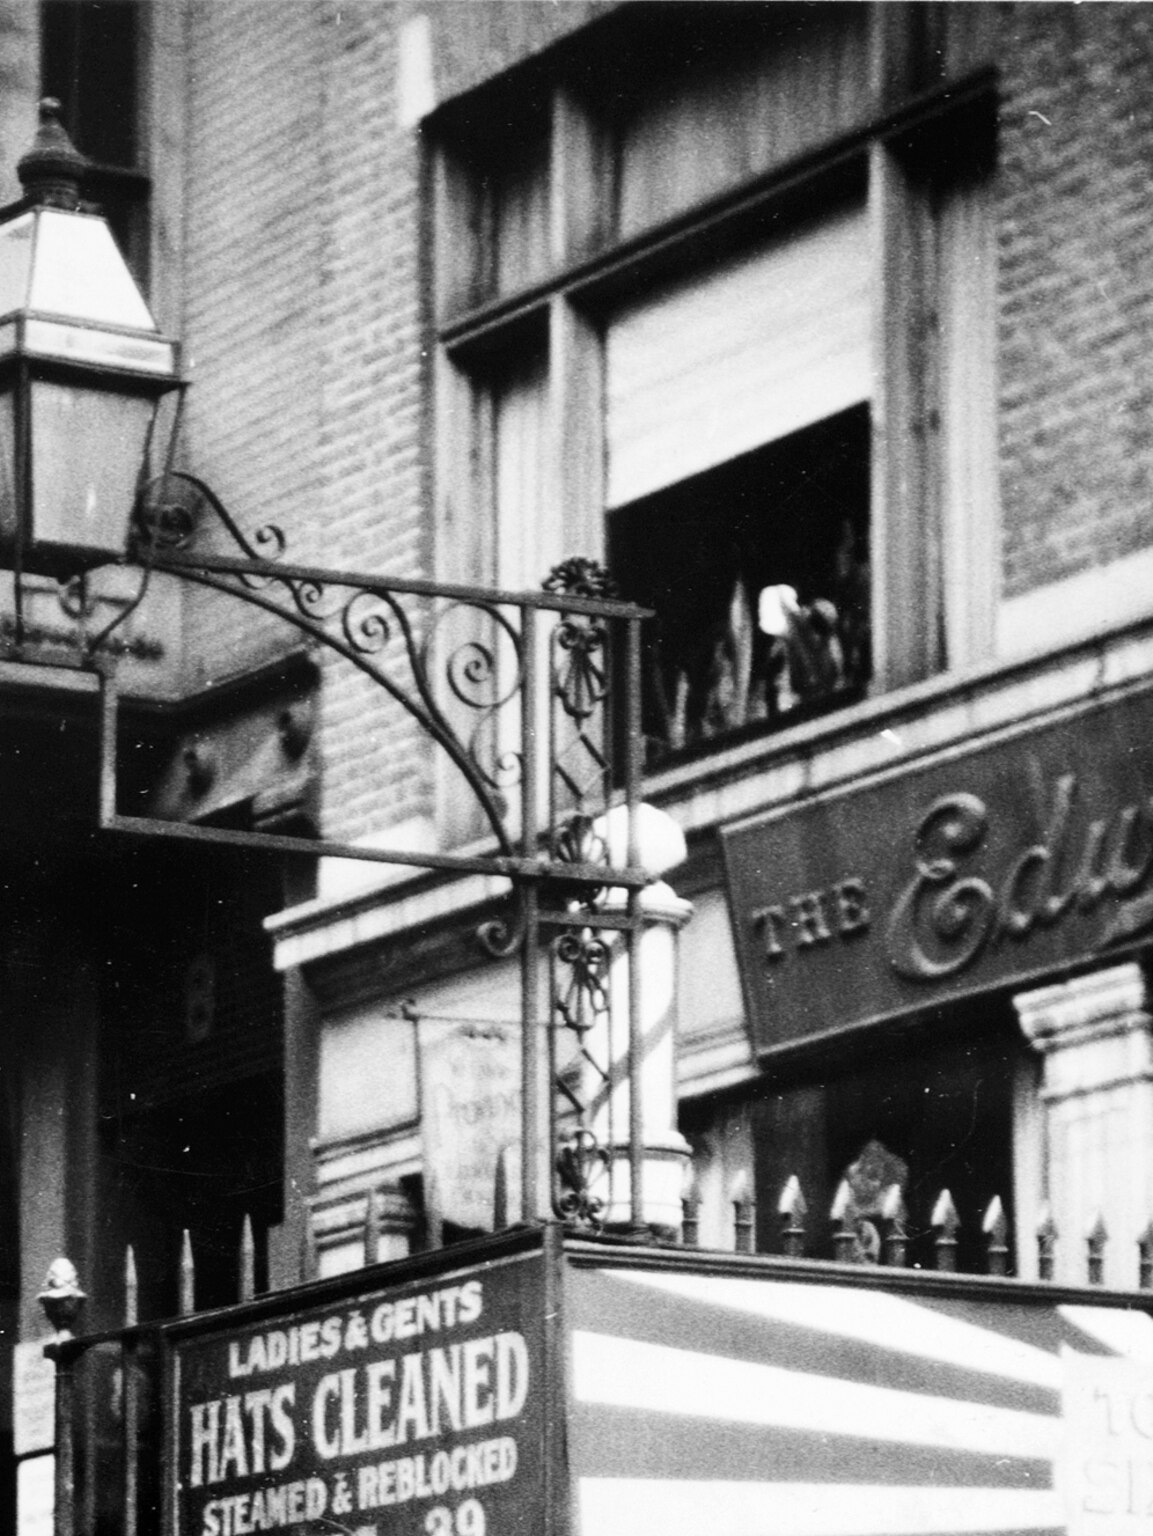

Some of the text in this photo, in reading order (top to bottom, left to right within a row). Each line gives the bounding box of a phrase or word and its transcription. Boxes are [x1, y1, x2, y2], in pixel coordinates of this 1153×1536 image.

[752, 878, 871, 954] THE
[229, 1281, 483, 1378] LADIES & GENTS
[189, 1383, 295, 1488] HATS
[313, 1331, 530, 1460] CLEANED
[332, 1472, 352, 1514] &
[358, 1436, 518, 1510] REBLOCKED
